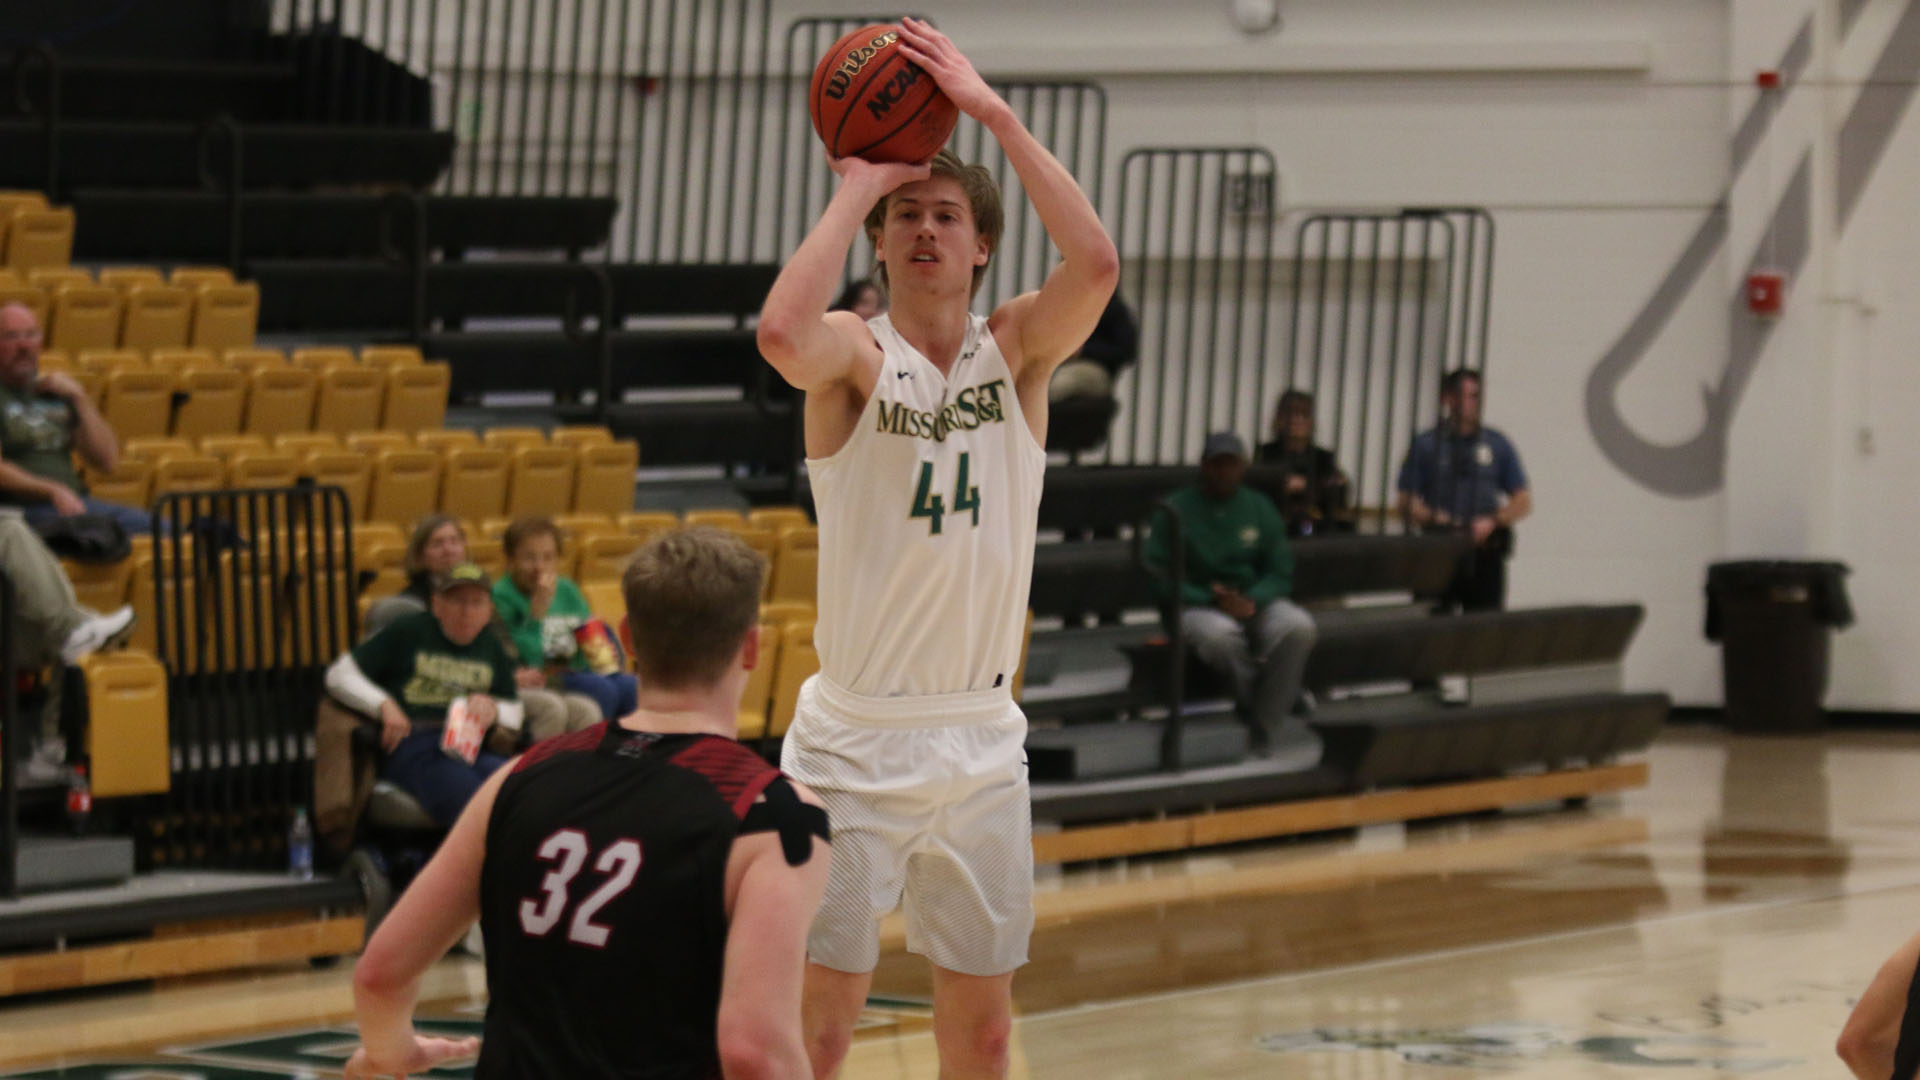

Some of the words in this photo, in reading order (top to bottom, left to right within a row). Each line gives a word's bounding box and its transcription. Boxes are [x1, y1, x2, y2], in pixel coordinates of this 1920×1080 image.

[876, 400, 962, 443] MISSORI
[956, 379, 1006, 431] S&T
[907, 452, 981, 537] 44
[518, 826, 645, 949] 32
